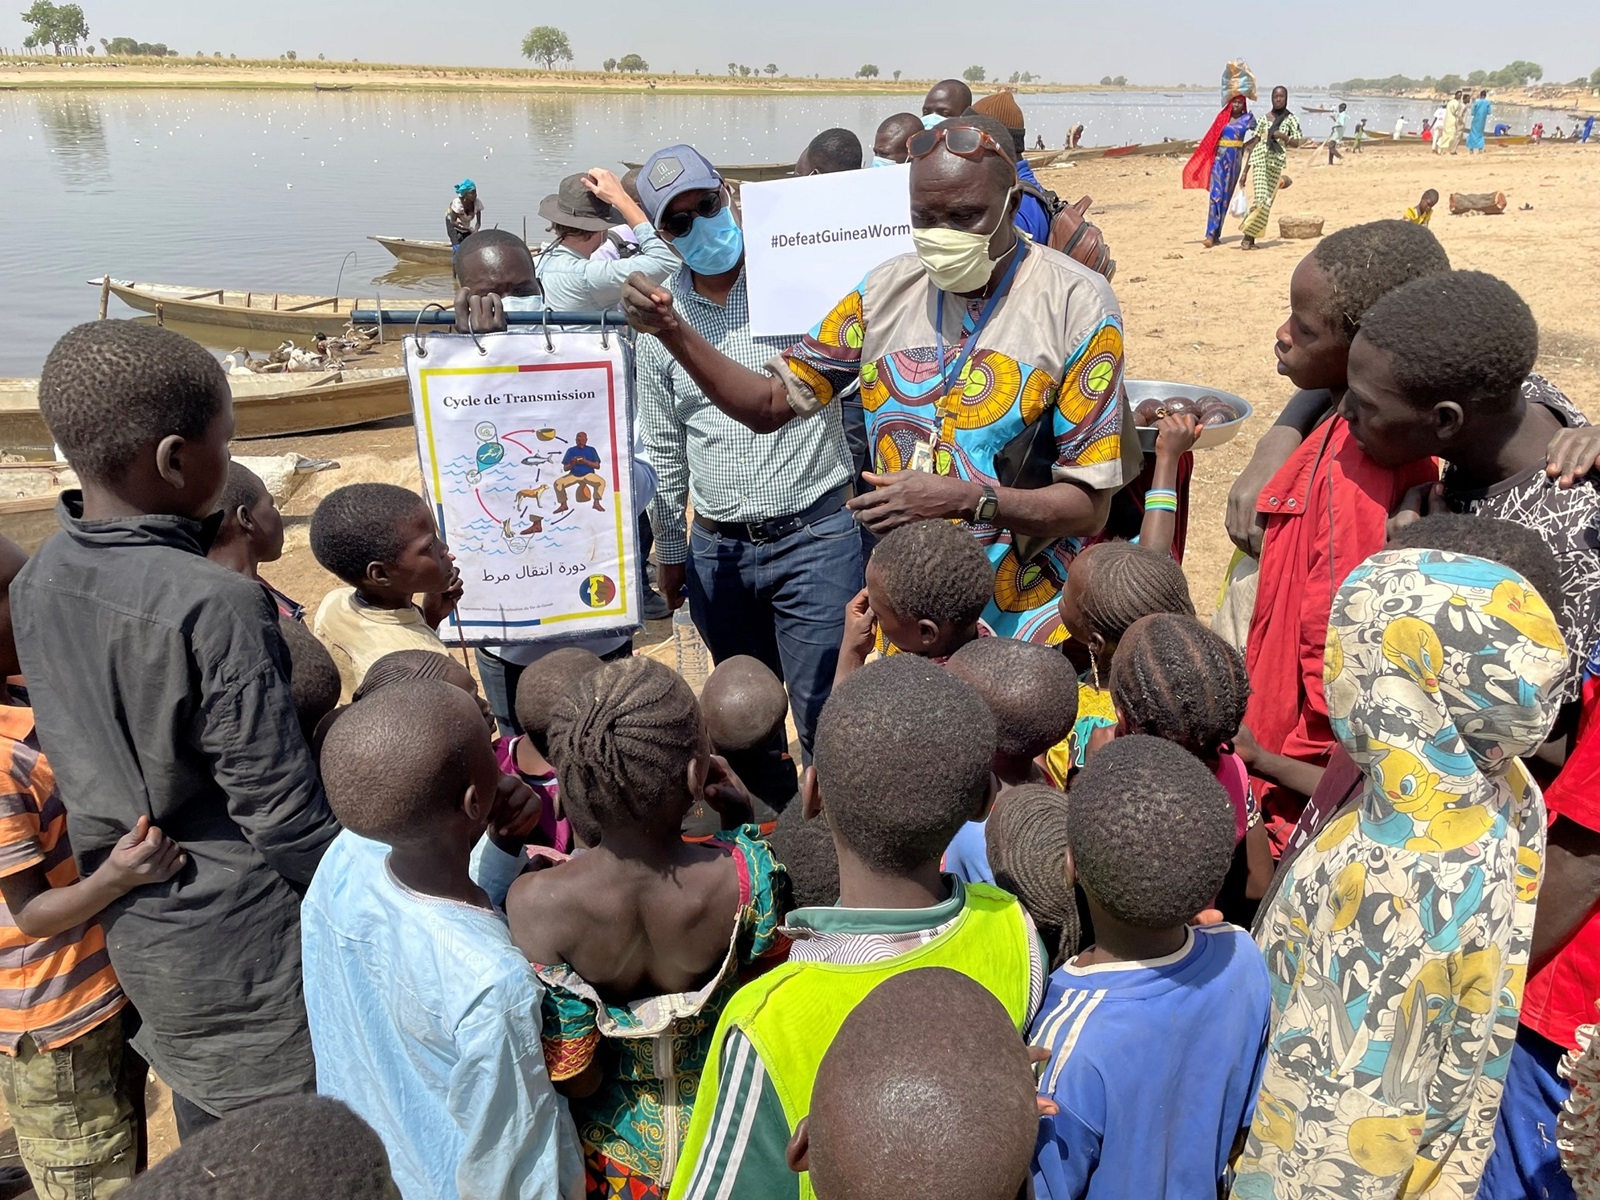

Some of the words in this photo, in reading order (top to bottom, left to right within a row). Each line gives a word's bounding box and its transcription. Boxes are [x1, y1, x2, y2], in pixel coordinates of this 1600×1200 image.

[771, 224, 911, 248] #DefeatGuineaWorm
[443, 395, 481, 409] Cycle
[484, 394, 501, 405] de
[503, 389, 596, 404] Transmission
[482, 569, 511, 584] مرط
[515, 562, 553, 580] انتقال
[558, 562, 587, 576] دورة
